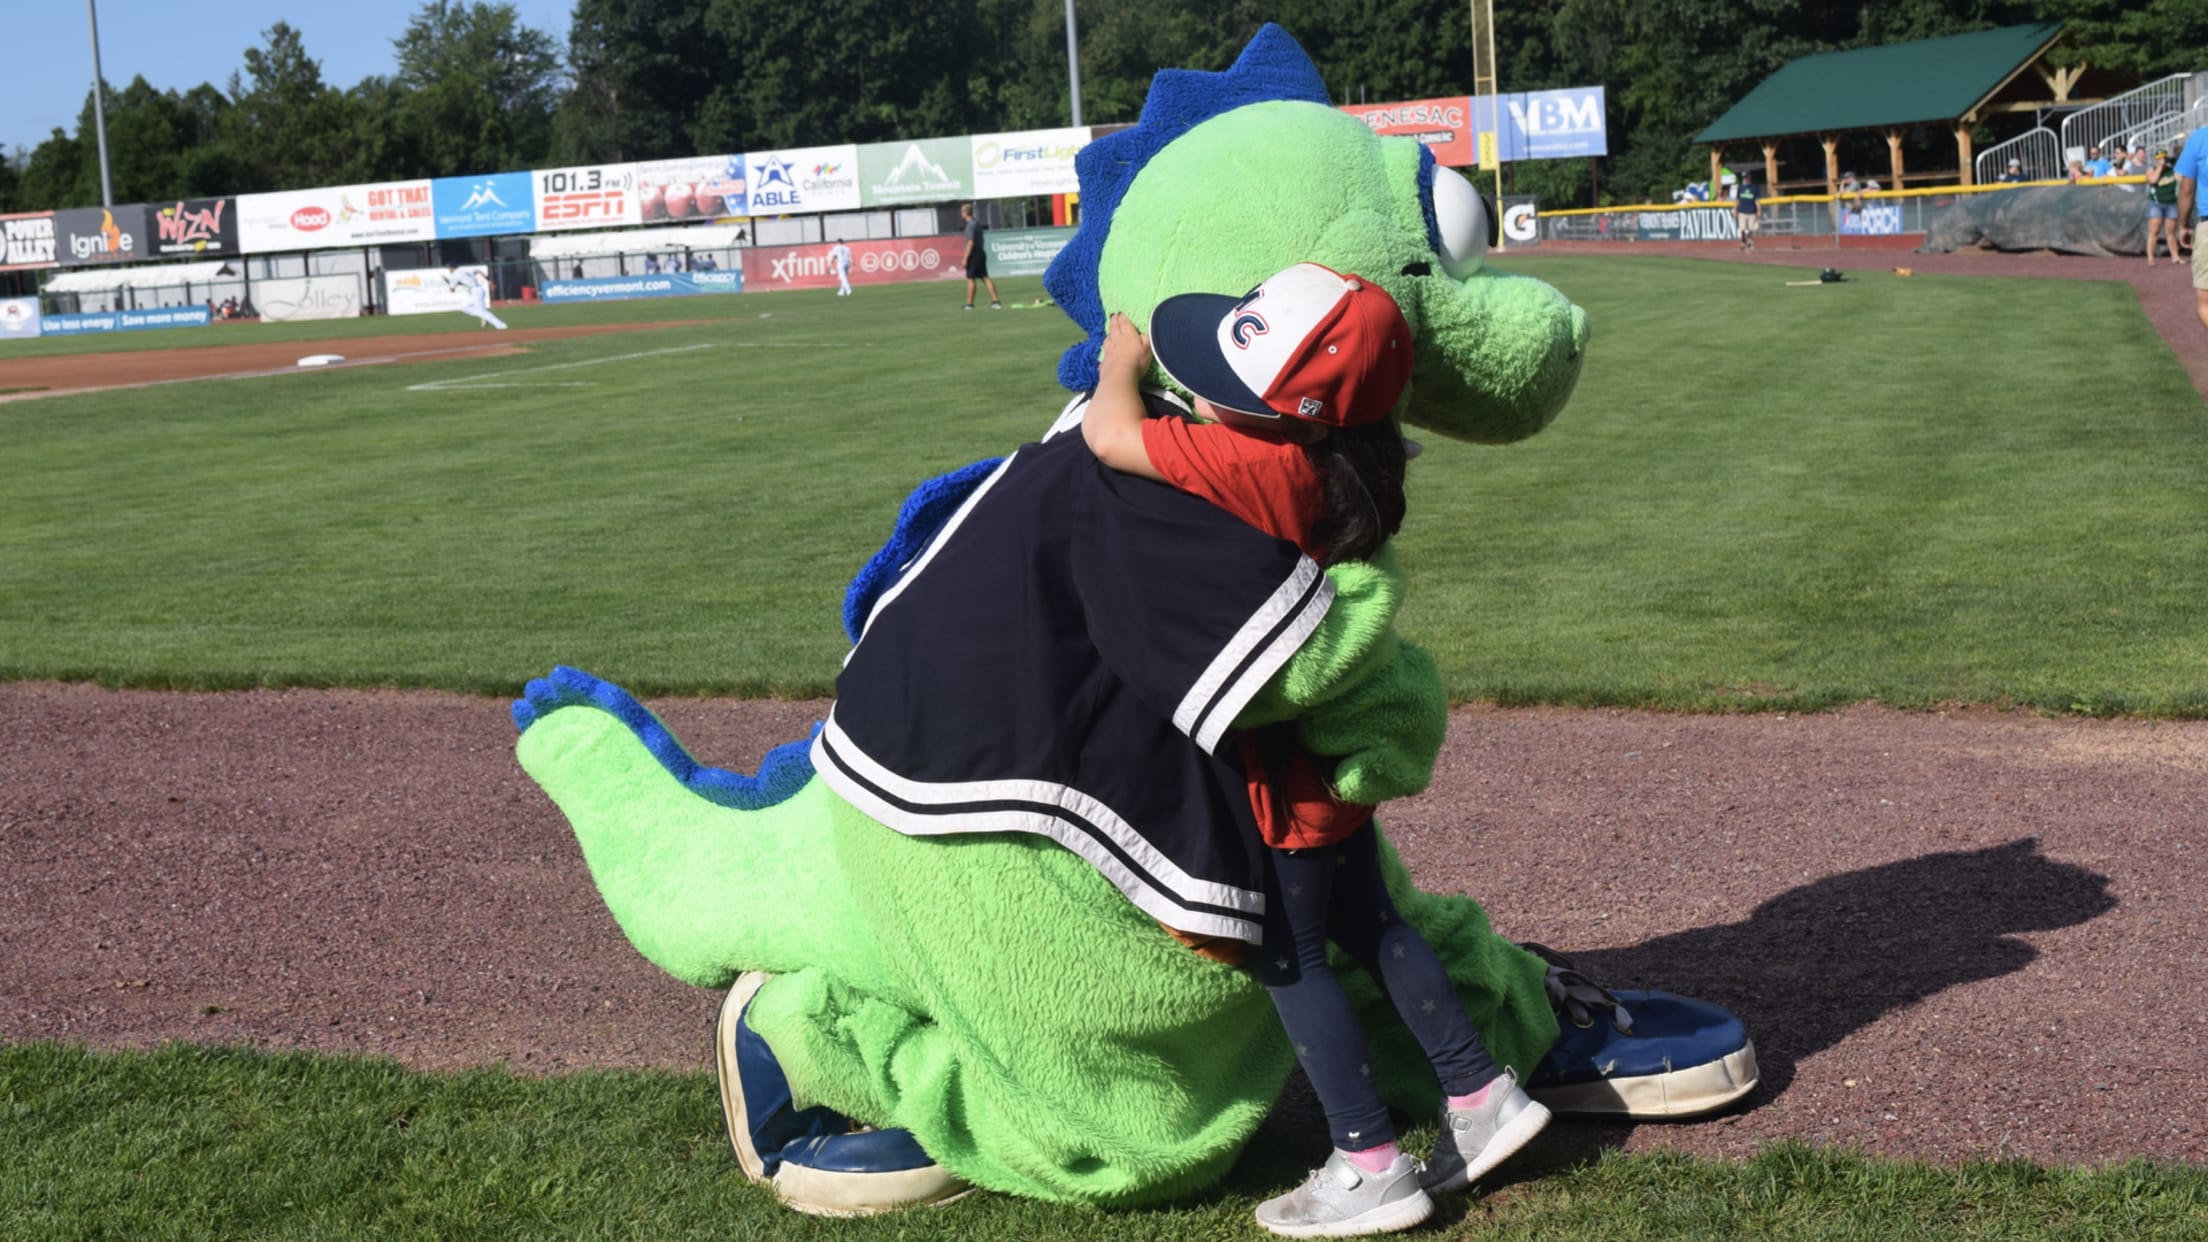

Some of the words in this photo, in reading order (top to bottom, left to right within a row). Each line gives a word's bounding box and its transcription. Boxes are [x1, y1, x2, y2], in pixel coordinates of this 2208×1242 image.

[1358, 104, 1463, 128] ENESAC
[1508, 94, 1601, 135] VBM
[543, 170, 602, 193] 101.3
[605, 179, 620, 188] FM
[802, 178, 853, 192] California
[872, 184, 922, 195] Mountain
[922, 181, 961, 191] Transit
[368, 189, 393, 207] GOT
[396, 186, 430, 204] THAT
[543, 191, 624, 220] ESPN
[752, 190, 801, 207] ABLE
[294, 212, 328, 227] Hood
[491, 209, 530, 222] Company
[5, 218, 54, 240] POWER
[7, 238, 56, 264] ALLEY
[546, 279, 671, 297] efficiencyvermont.com
[43, 320, 60, 331] Use
[61, 318, 80, 330] less
[82, 317, 115, 330] energy
[122, 313, 144, 327] Save
[145, 312, 171, 324] more
[173, 310, 208, 323] money
